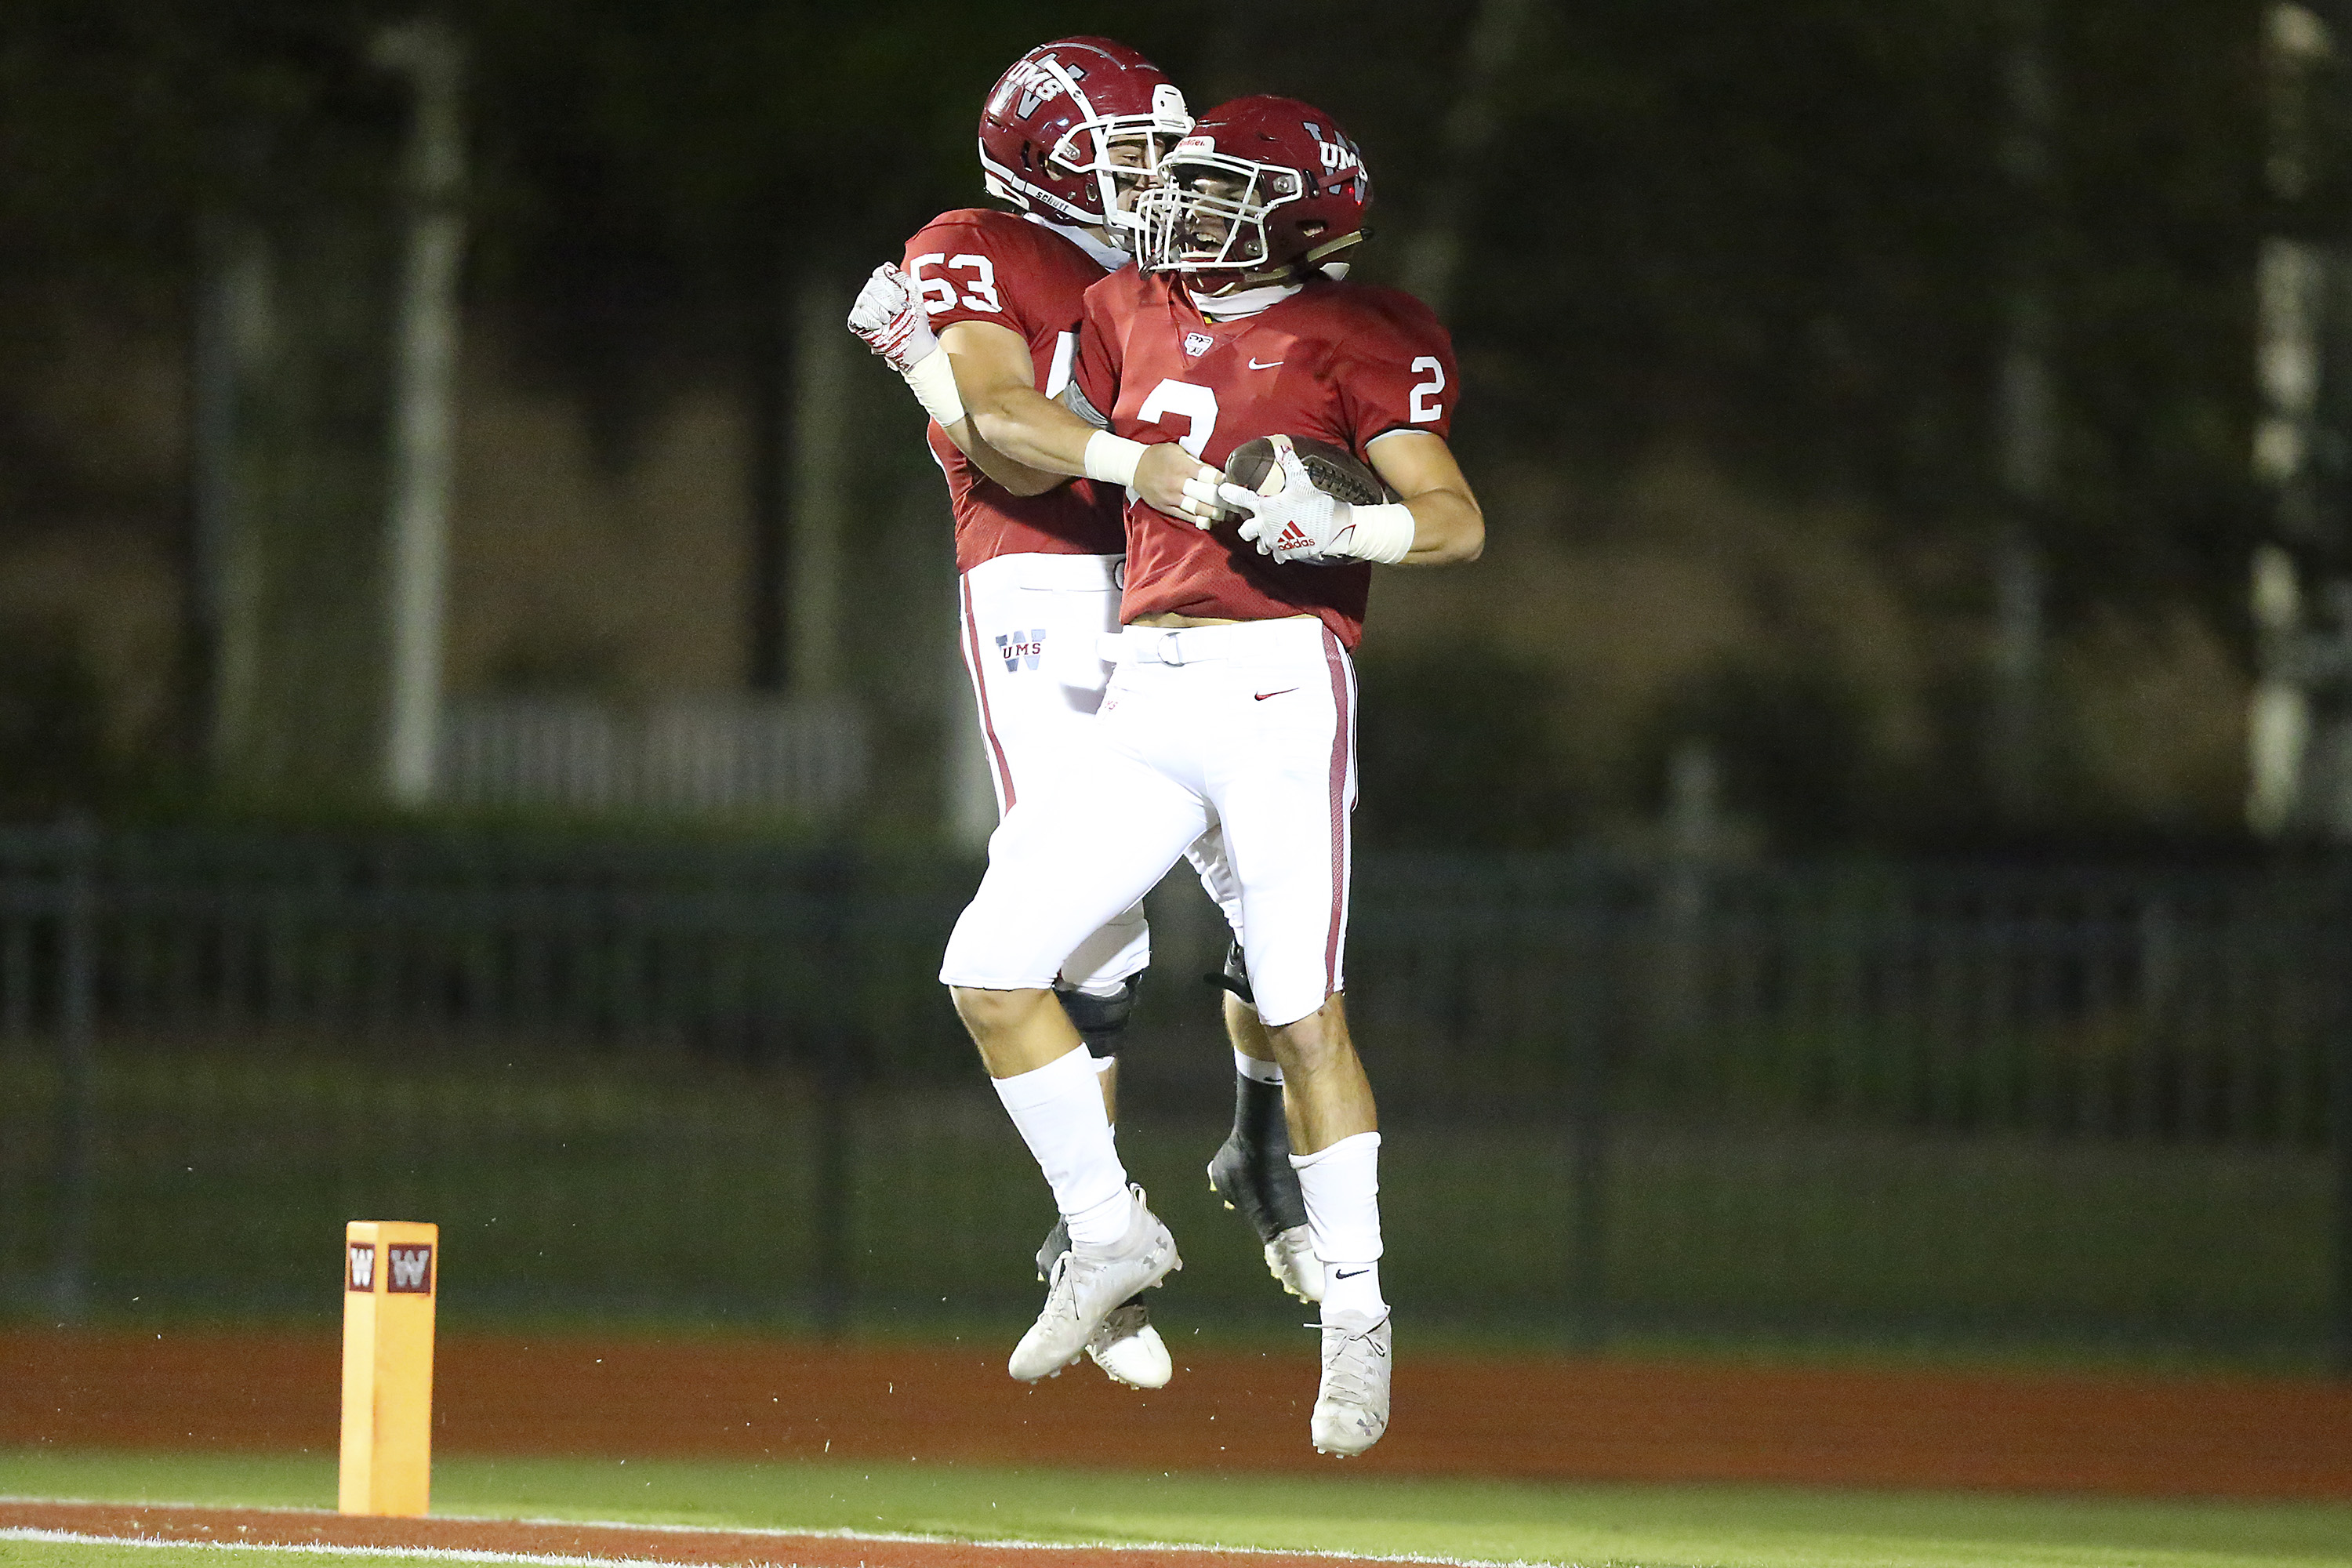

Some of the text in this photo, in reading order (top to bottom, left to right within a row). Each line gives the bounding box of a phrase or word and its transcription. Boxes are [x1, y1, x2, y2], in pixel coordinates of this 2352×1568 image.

[1409, 356, 1446, 423] 2
[1278, 539, 1316, 550] adidas
[1004, 643, 1041, 659] UMS
[350, 1247, 374, 1287] W
[391, 1249, 430, 1288] W
